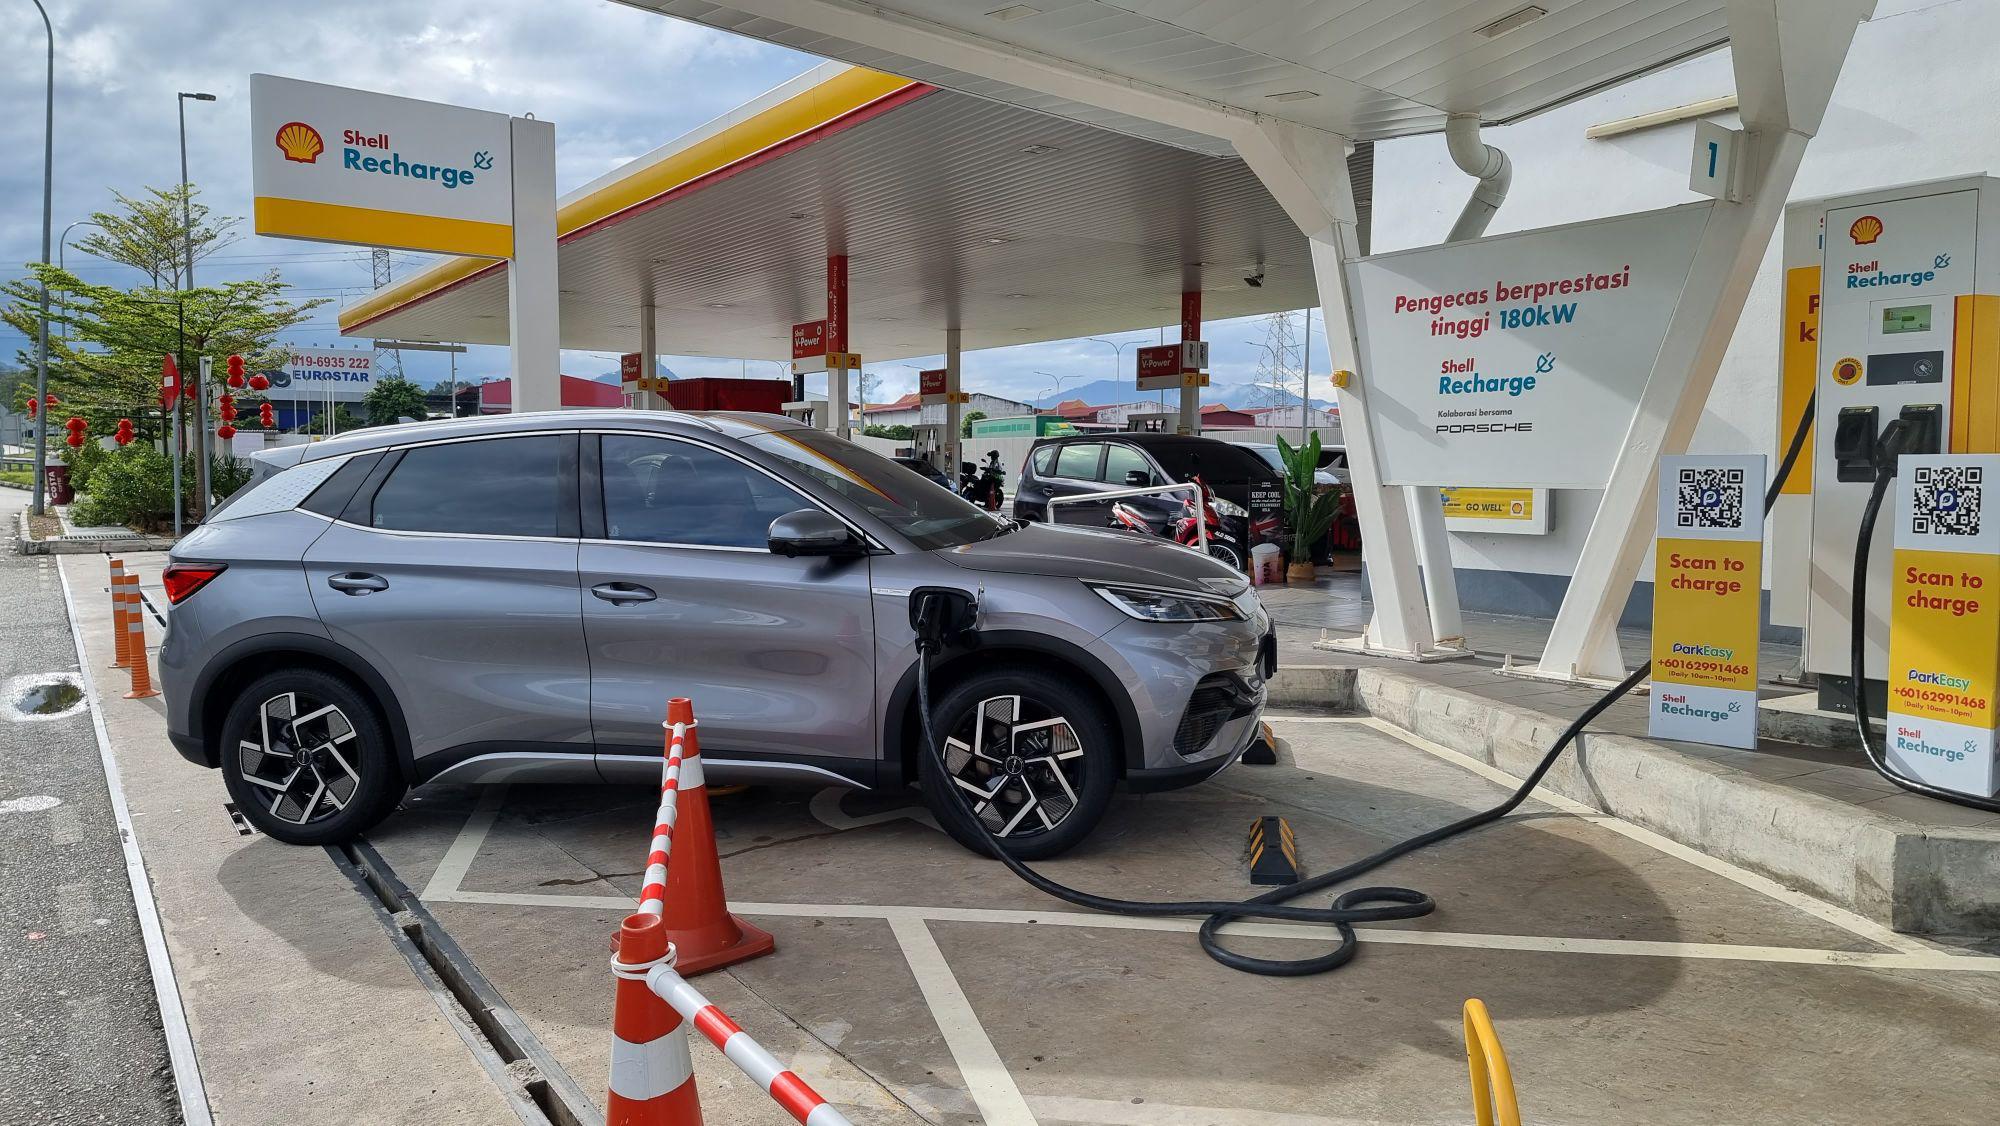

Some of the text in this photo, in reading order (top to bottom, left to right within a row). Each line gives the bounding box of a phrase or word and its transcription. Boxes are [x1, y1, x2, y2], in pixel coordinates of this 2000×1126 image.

[343, 129, 389, 150] Shell
[1708, 141, 1718, 178] 1
[343, 148, 475, 189] Recharge
[1848, 260, 1879, 274] Shell
[1847, 271, 1935, 289] Recharge
[1394, 265, 1631, 315] Pengecas berprestasi
[1430, 302, 1578, 340] tinggi 180kW
[795, 336, 820, 347] V-Power
[348, 357, 370, 369] 222
[832, 357, 836, 365] 1
[850, 358, 857, 366] 2
[1142, 359, 1171, 369] V-Power
[1441, 357, 1475, 374] Shell
[292, 369, 369, 382] EUROSTAR
[657, 381, 663, 389] 4
[1439, 372, 1536, 397] Recharge
[1437, 408, 1513, 418] Kolaborasi bersama
[1436, 423, 1533, 434] PORSCHE
[48, 471, 58, 499] COSTA
[1251, 491, 1281, 499] KEEP COOL
[1466, 503, 1480, 512] GO
[1482, 503, 1502, 512] WELL
[1670, 553, 1745, 571] Scan to
[1670, 573, 1742, 596] charge
[1906, 566, 1983, 589] Scan to
[1907, 589, 1979, 617] charge
[1673, 642, 1733, 661] ParkEasy
[1657, 658, 1749, 675] +60162991468
[1668, 670, 1689, 678] (Daily
[1908, 669, 1970, 692] ParkEasy
[1662, 693, 1686, 704] Shell
[1893, 686, 1987, 710] +60162991468
[1903, 699, 1924, 711] (Daily
[1661, 702, 1729, 722] Recharge
[1898, 727, 1921, 739] Shell
[1897, 737, 1965, 763] Recharge
